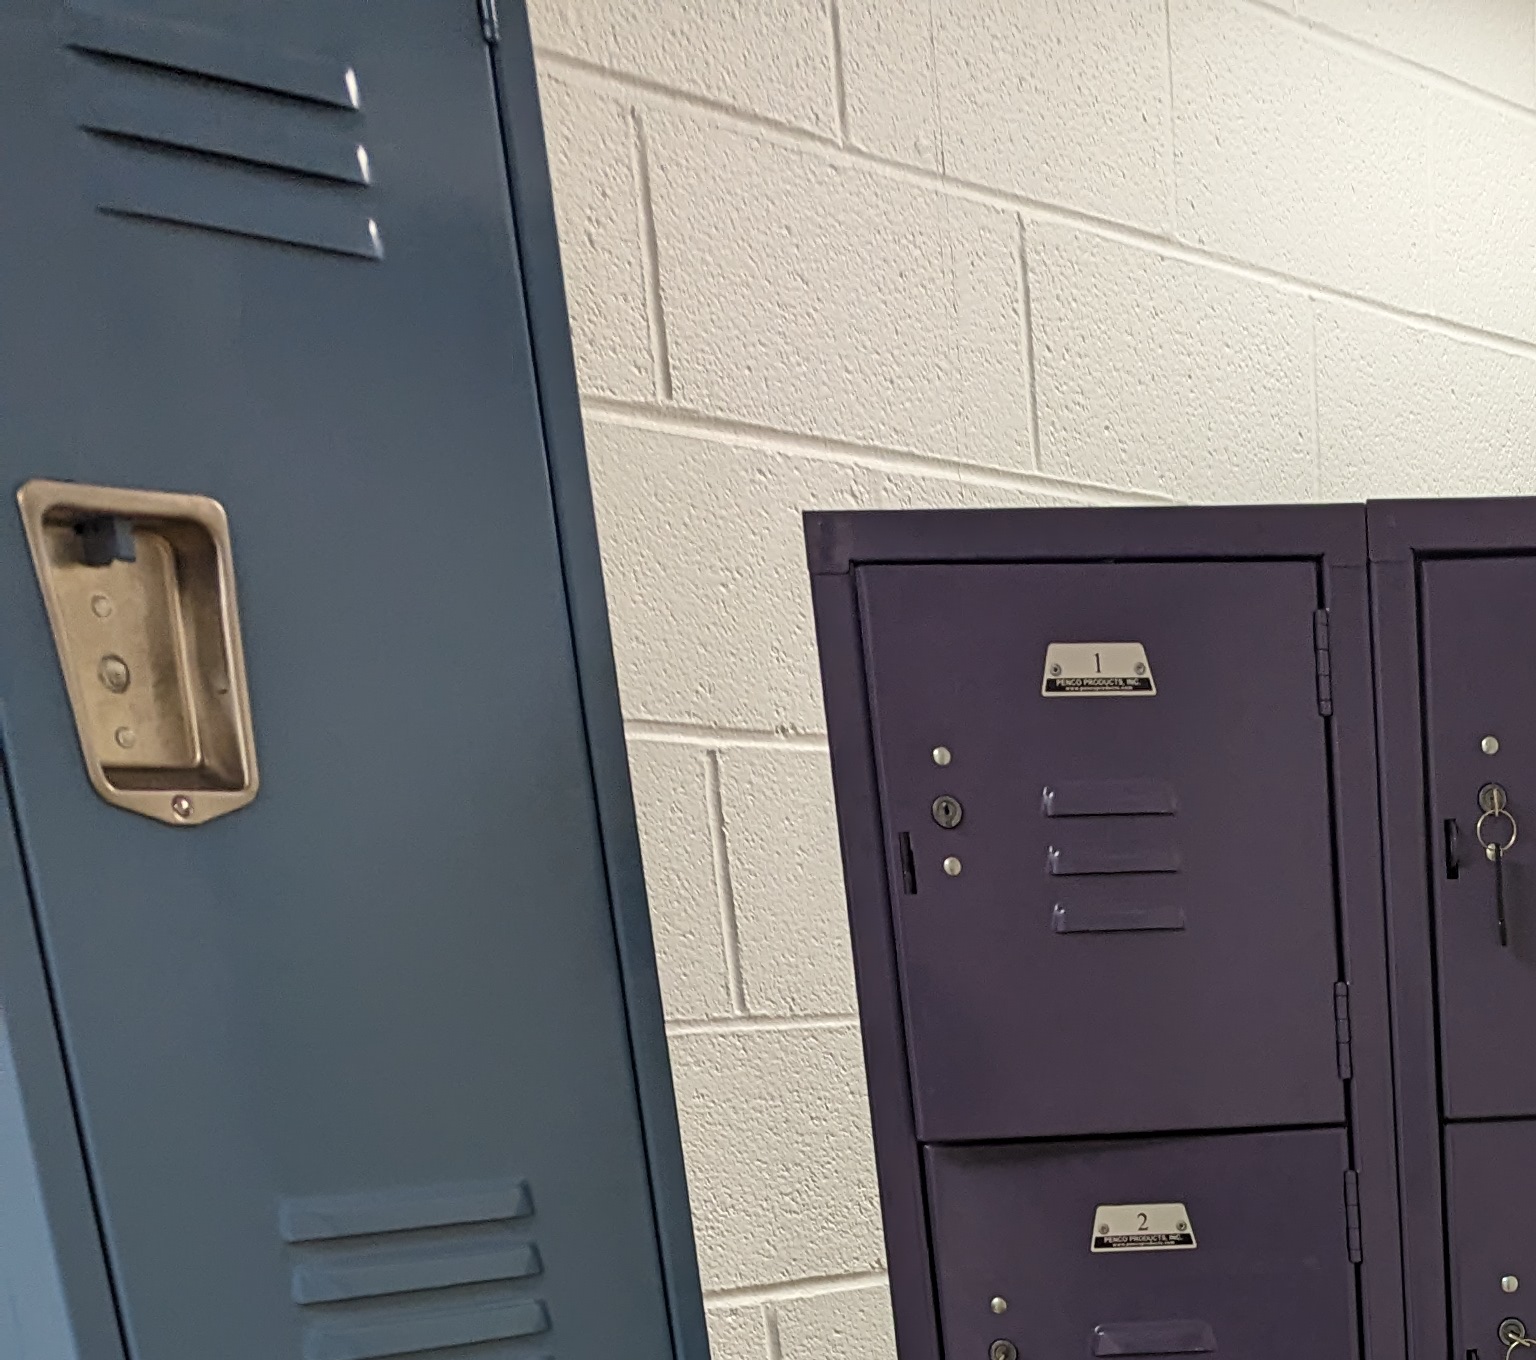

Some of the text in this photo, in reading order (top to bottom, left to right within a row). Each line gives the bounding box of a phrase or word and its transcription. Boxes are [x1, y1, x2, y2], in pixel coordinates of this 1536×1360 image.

[1094, 652, 1101, 673] 1
[1083, 678, 1125, 687] PRODUCTS,
[1126, 678, 1141, 686] INC.
[1137, 1212, 1149, 1231] 2
